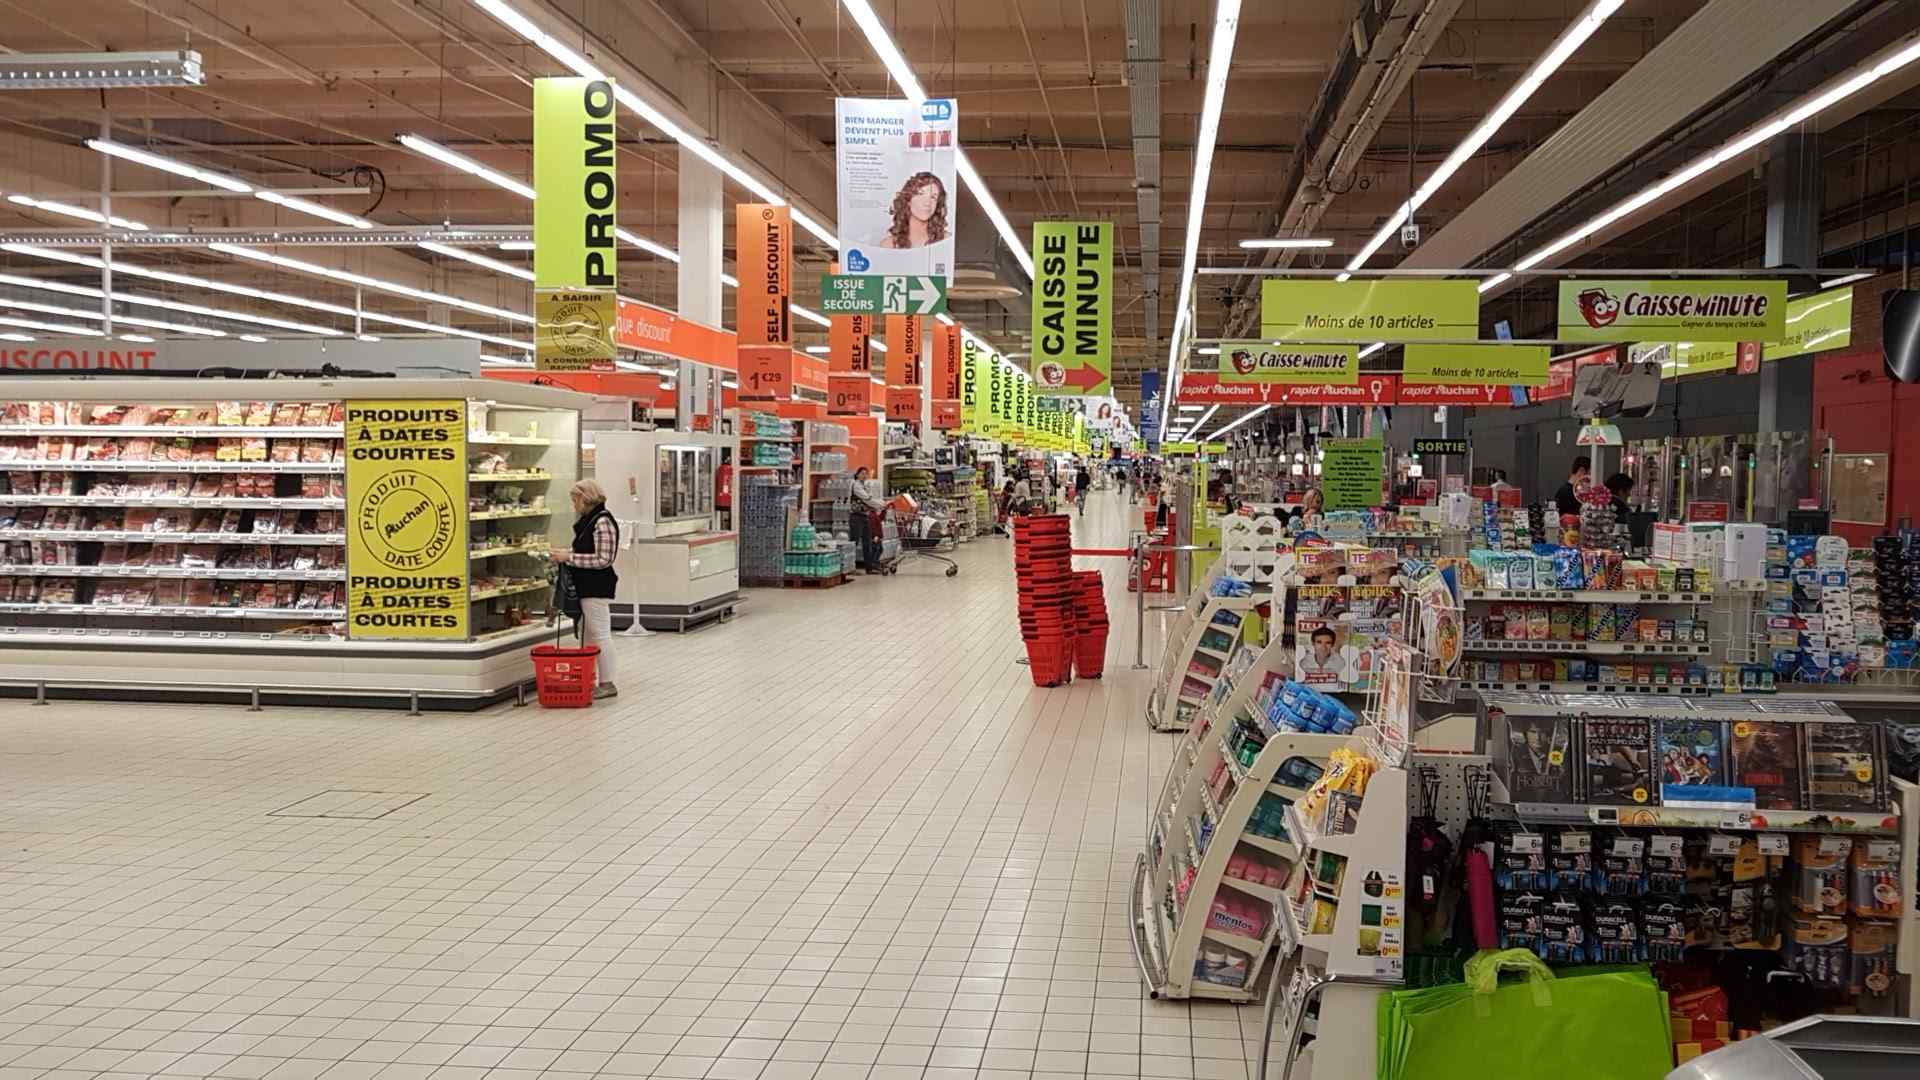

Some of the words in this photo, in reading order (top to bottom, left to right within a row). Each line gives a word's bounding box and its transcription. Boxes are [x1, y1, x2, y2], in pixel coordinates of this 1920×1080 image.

[844, 116, 865, 125] BIEN
[867, 117, 904, 126] MANGER
[845, 126, 881, 136] DEVIENT
[882, 127, 904, 136] PLUS
[845, 136, 878, 145] SIMPLE.
[584, 80, 615, 286] PROMO
[768, 223, 779, 295] DISCOUNT
[833, 279, 865, 290] ISSUE
[1075, 225, 1100, 355] MINUTE
[562, 294, 602, 302] SAISIR
[841, 289, 857, 300] DE
[1042, 235, 1066, 356] CAISSE
[823, 299, 874, 311] SECOURS
[768, 309, 779, 343] SELF
[1304, 315, 1345, 329] Moins
[1348, 315, 1366, 329] de
[1369, 315, 1385, 329] 10
[1387, 315, 1435, 329] articles
[637, 318, 672, 344] discount
[1, 349, 157, 370] ISCOUNT
[852, 344, 863, 371] SELF
[905, 363, 914, 384] SELF
[964, 339, 975, 406] PROMO
[1432, 368, 1459, 377] Moins
[1461, 368, 1473, 377] de
[1475, 368, 1485, 378] 10
[1487, 368, 1519, 379] articles
[991, 353, 1001, 414] PROMO
[1212, 384, 1255, 395] Auchan
[1322, 383, 1365, 395] Auchan
[1433, 384, 1480, 396] Auchan
[1003, 366, 1013, 420] PROMO
[1016, 373, 1025, 423] PROMO
[349, 409, 459, 423] PRODUITS
[358, 425, 373, 442] À
[380, 428, 450, 442] DATES
[352, 447, 456, 461] COURTES
[1416, 441, 1466, 453] SORTIE
[363, 474, 419, 531] PRODUIT
[383, 499, 431, 540] Auchan
[385, 551, 425, 568] DATE
[425, 500, 450, 560] COURTE
[351, 575, 461, 590] PRODUITS
[361, 591, 375, 608] À
[382, 595, 452, 609] DATES
[355, 613, 458, 628] COURTES
[1214, 911, 1253, 930] mentos
[1544, 914, 1575, 923] DURACELL
[1646, 914, 1677, 923] DURACELL
